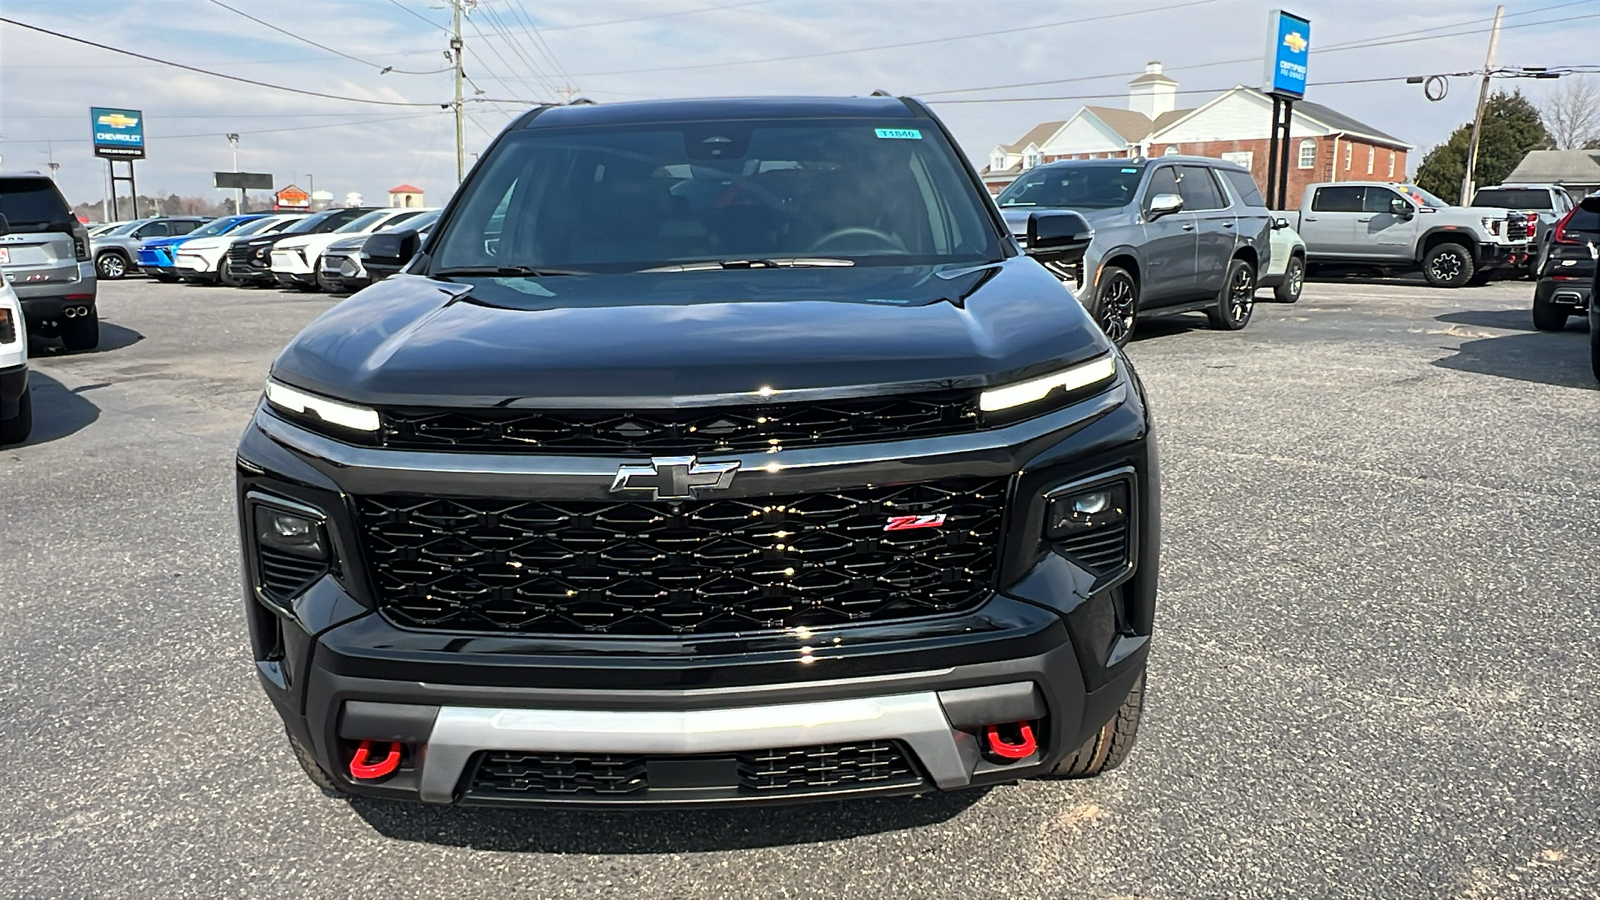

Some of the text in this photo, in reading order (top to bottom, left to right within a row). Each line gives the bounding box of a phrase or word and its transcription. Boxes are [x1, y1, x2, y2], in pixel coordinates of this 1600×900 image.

[1280, 60, 1306, 74] CERTIFIED
[97, 133, 141, 142] CHEVROLET
[880, 130, 915, 138] T1840
[883, 513, 947, 531] Z71
